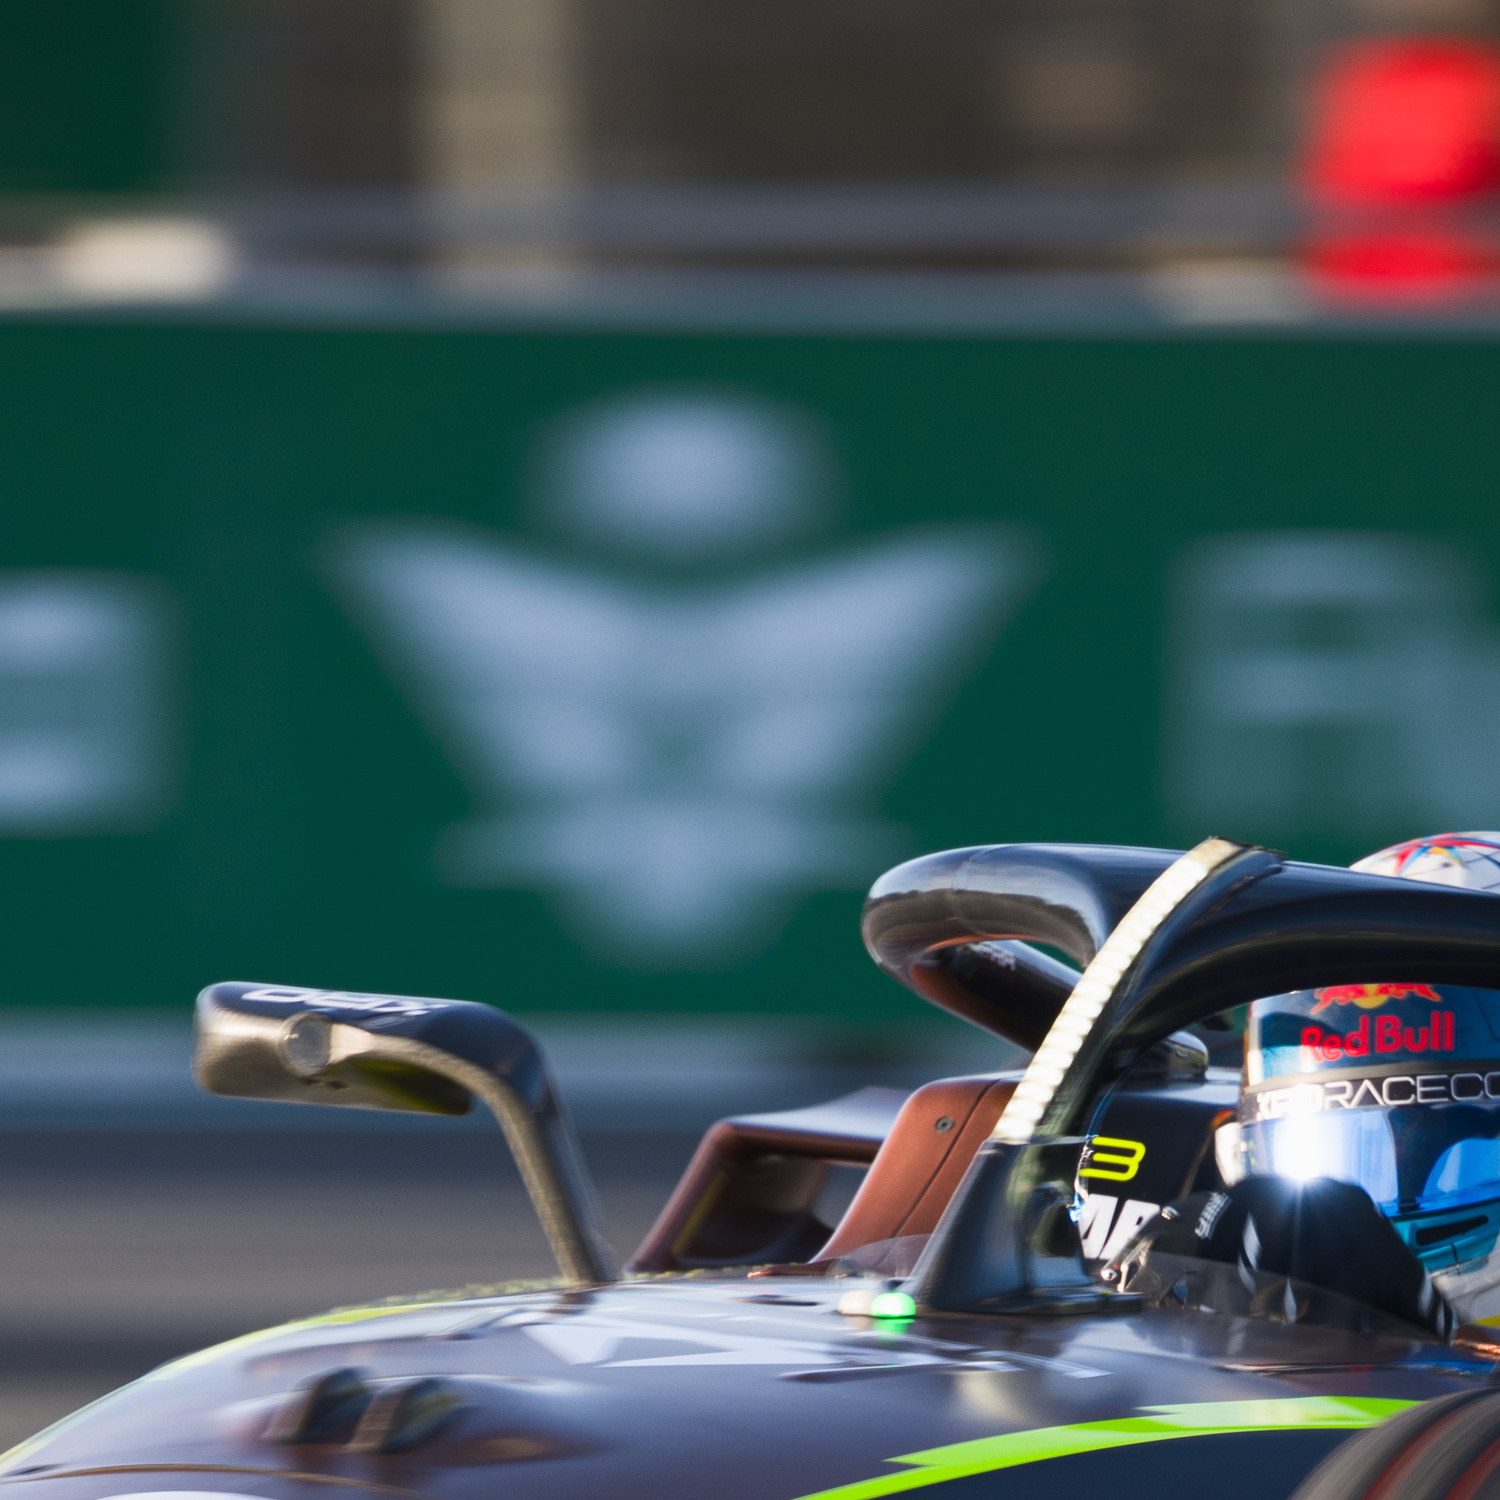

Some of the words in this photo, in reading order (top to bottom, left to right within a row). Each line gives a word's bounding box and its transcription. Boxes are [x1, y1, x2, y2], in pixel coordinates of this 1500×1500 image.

[1300, 1015, 1369, 1062] Red
[1374, 1010, 1455, 1053] Bull
[1079, 1136, 1146, 1182] 3
